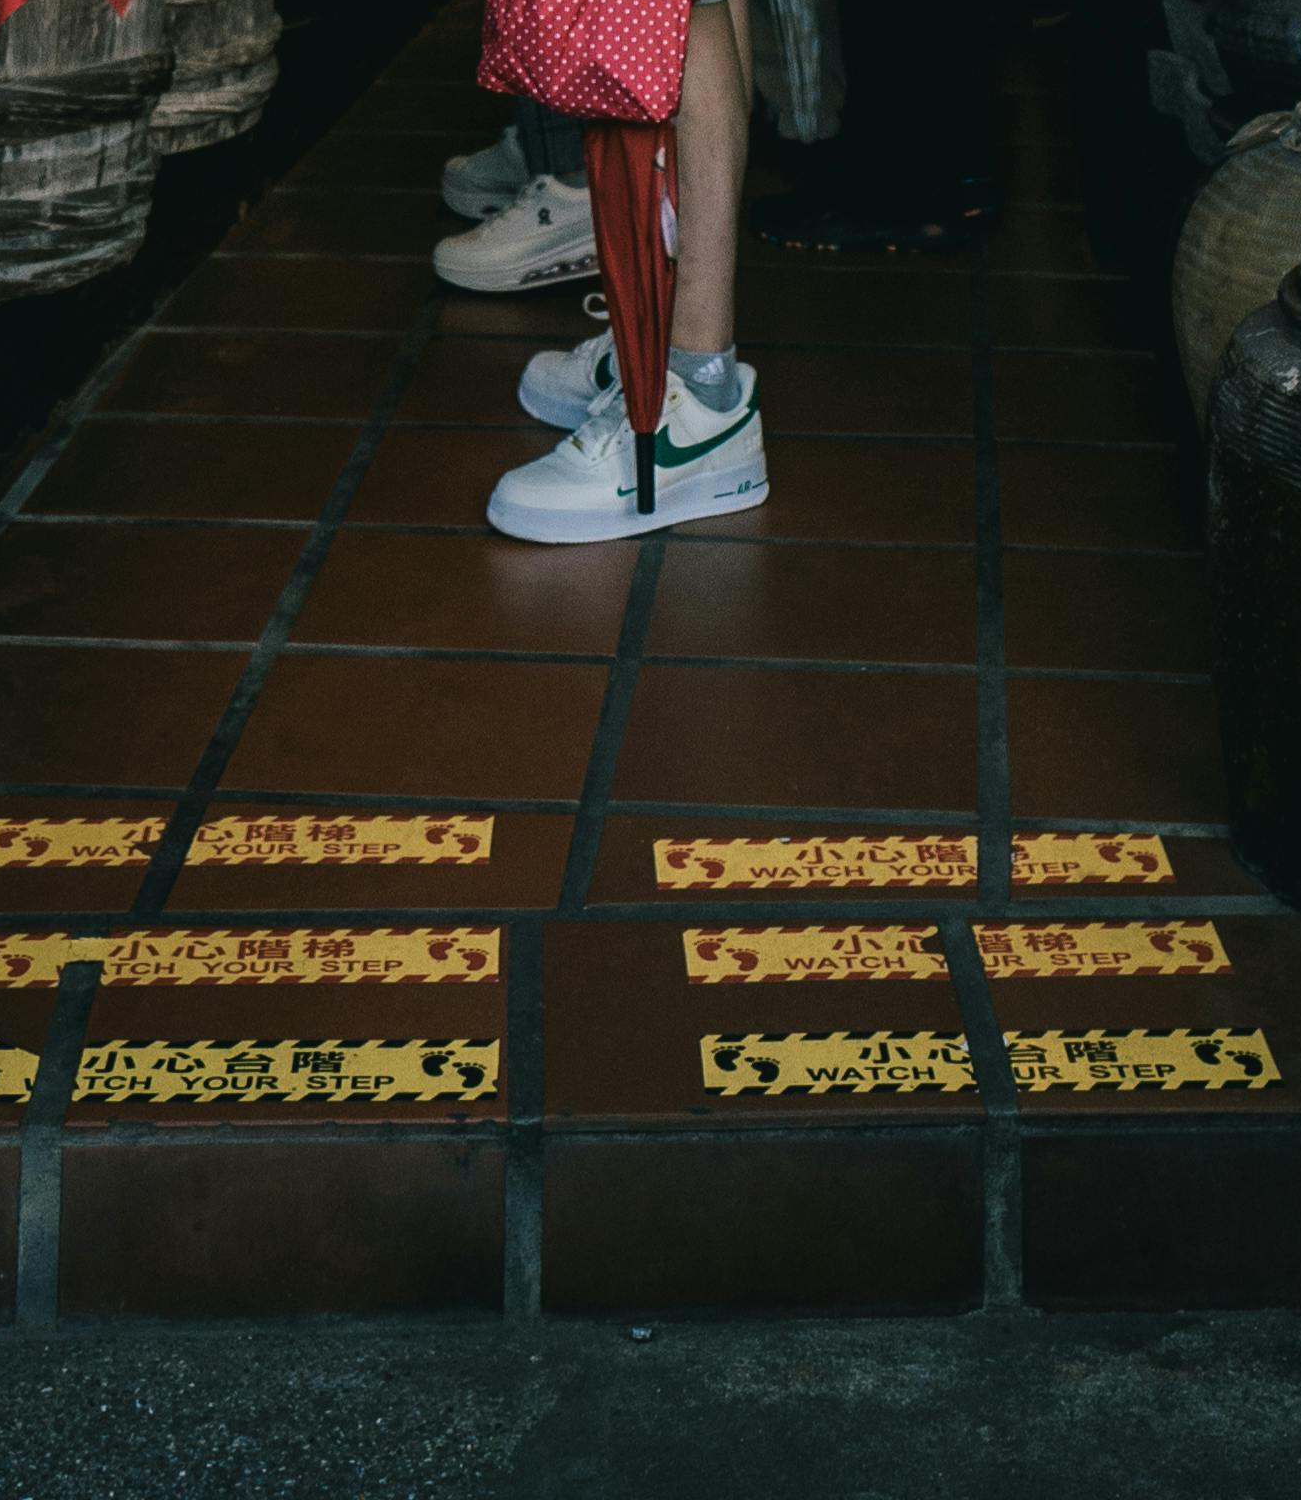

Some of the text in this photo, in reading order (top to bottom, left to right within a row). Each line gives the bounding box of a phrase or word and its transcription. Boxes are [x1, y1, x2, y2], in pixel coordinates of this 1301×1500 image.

[121, 822, 359, 844] 小心階梯
[71, 842, 402, 858] WAT YOUR STEP
[749, 864, 866, 879] WATCH
[890, 863, 979, 879] YOUR
[108, 938, 357, 961] 小心階梯
[56, 958, 404, 977] TCH YOUR STEP
[783, 952, 1133, 972] WATCH YUR STEP
[83, 1050, 346, 1074] 小心台階
[858, 1040, 1120, 1066] 小心台階
[806, 1062, 1177, 1082] WATCH YUR STEP
[23, 1073, 396, 1092] TCH YOUR STEP
